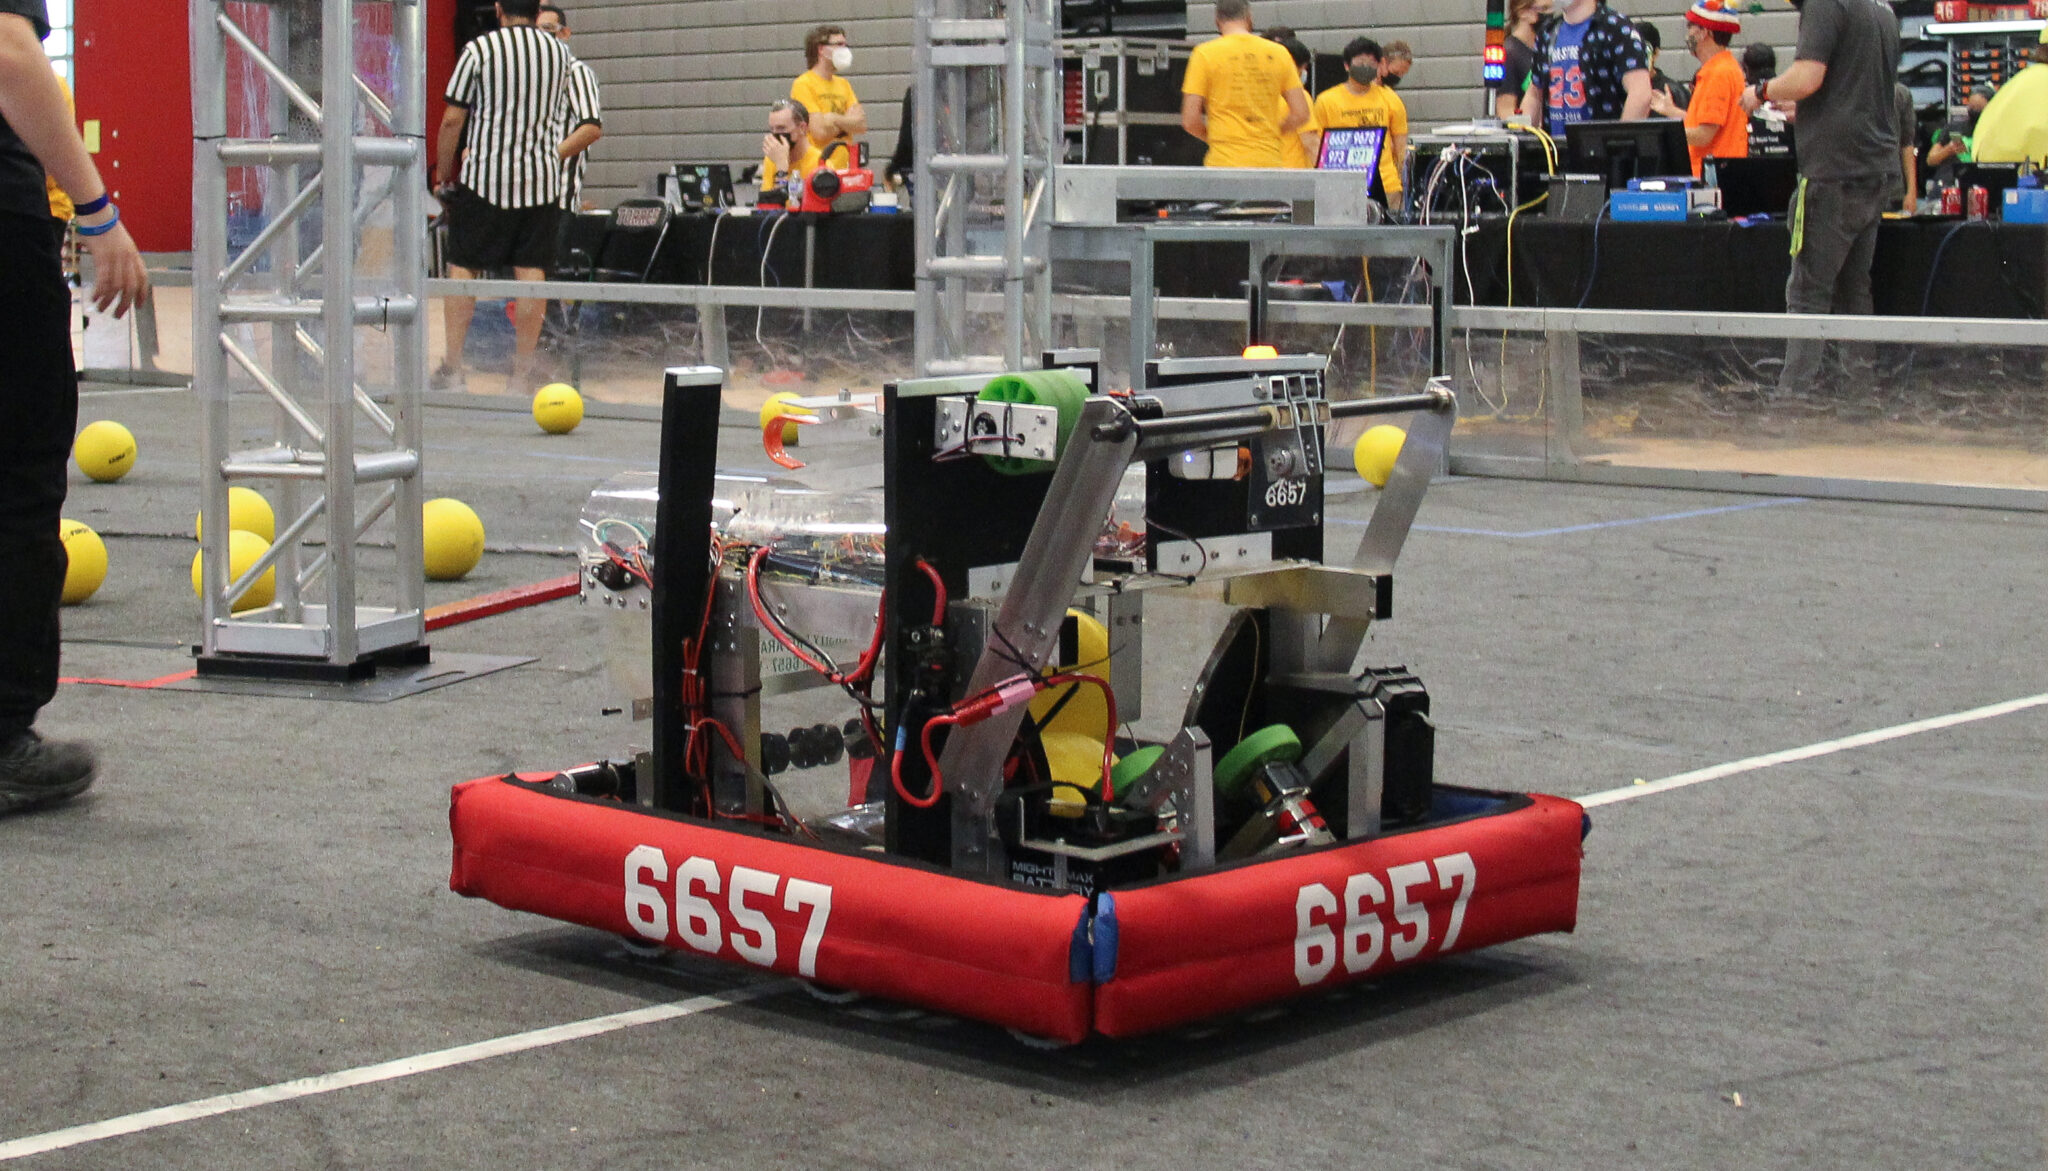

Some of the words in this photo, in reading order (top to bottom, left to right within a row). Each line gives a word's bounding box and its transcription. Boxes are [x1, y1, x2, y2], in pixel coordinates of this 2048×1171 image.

[1549, 66, 1587, 108] 23
[1265, 478, 1306, 507] 6657
[1012, 861, 1057, 877] MIGHT
[1012, 873, 1095, 898] BATTRY
[624, 845, 833, 979] 6657
[1294, 852, 1476, 986] 6657
